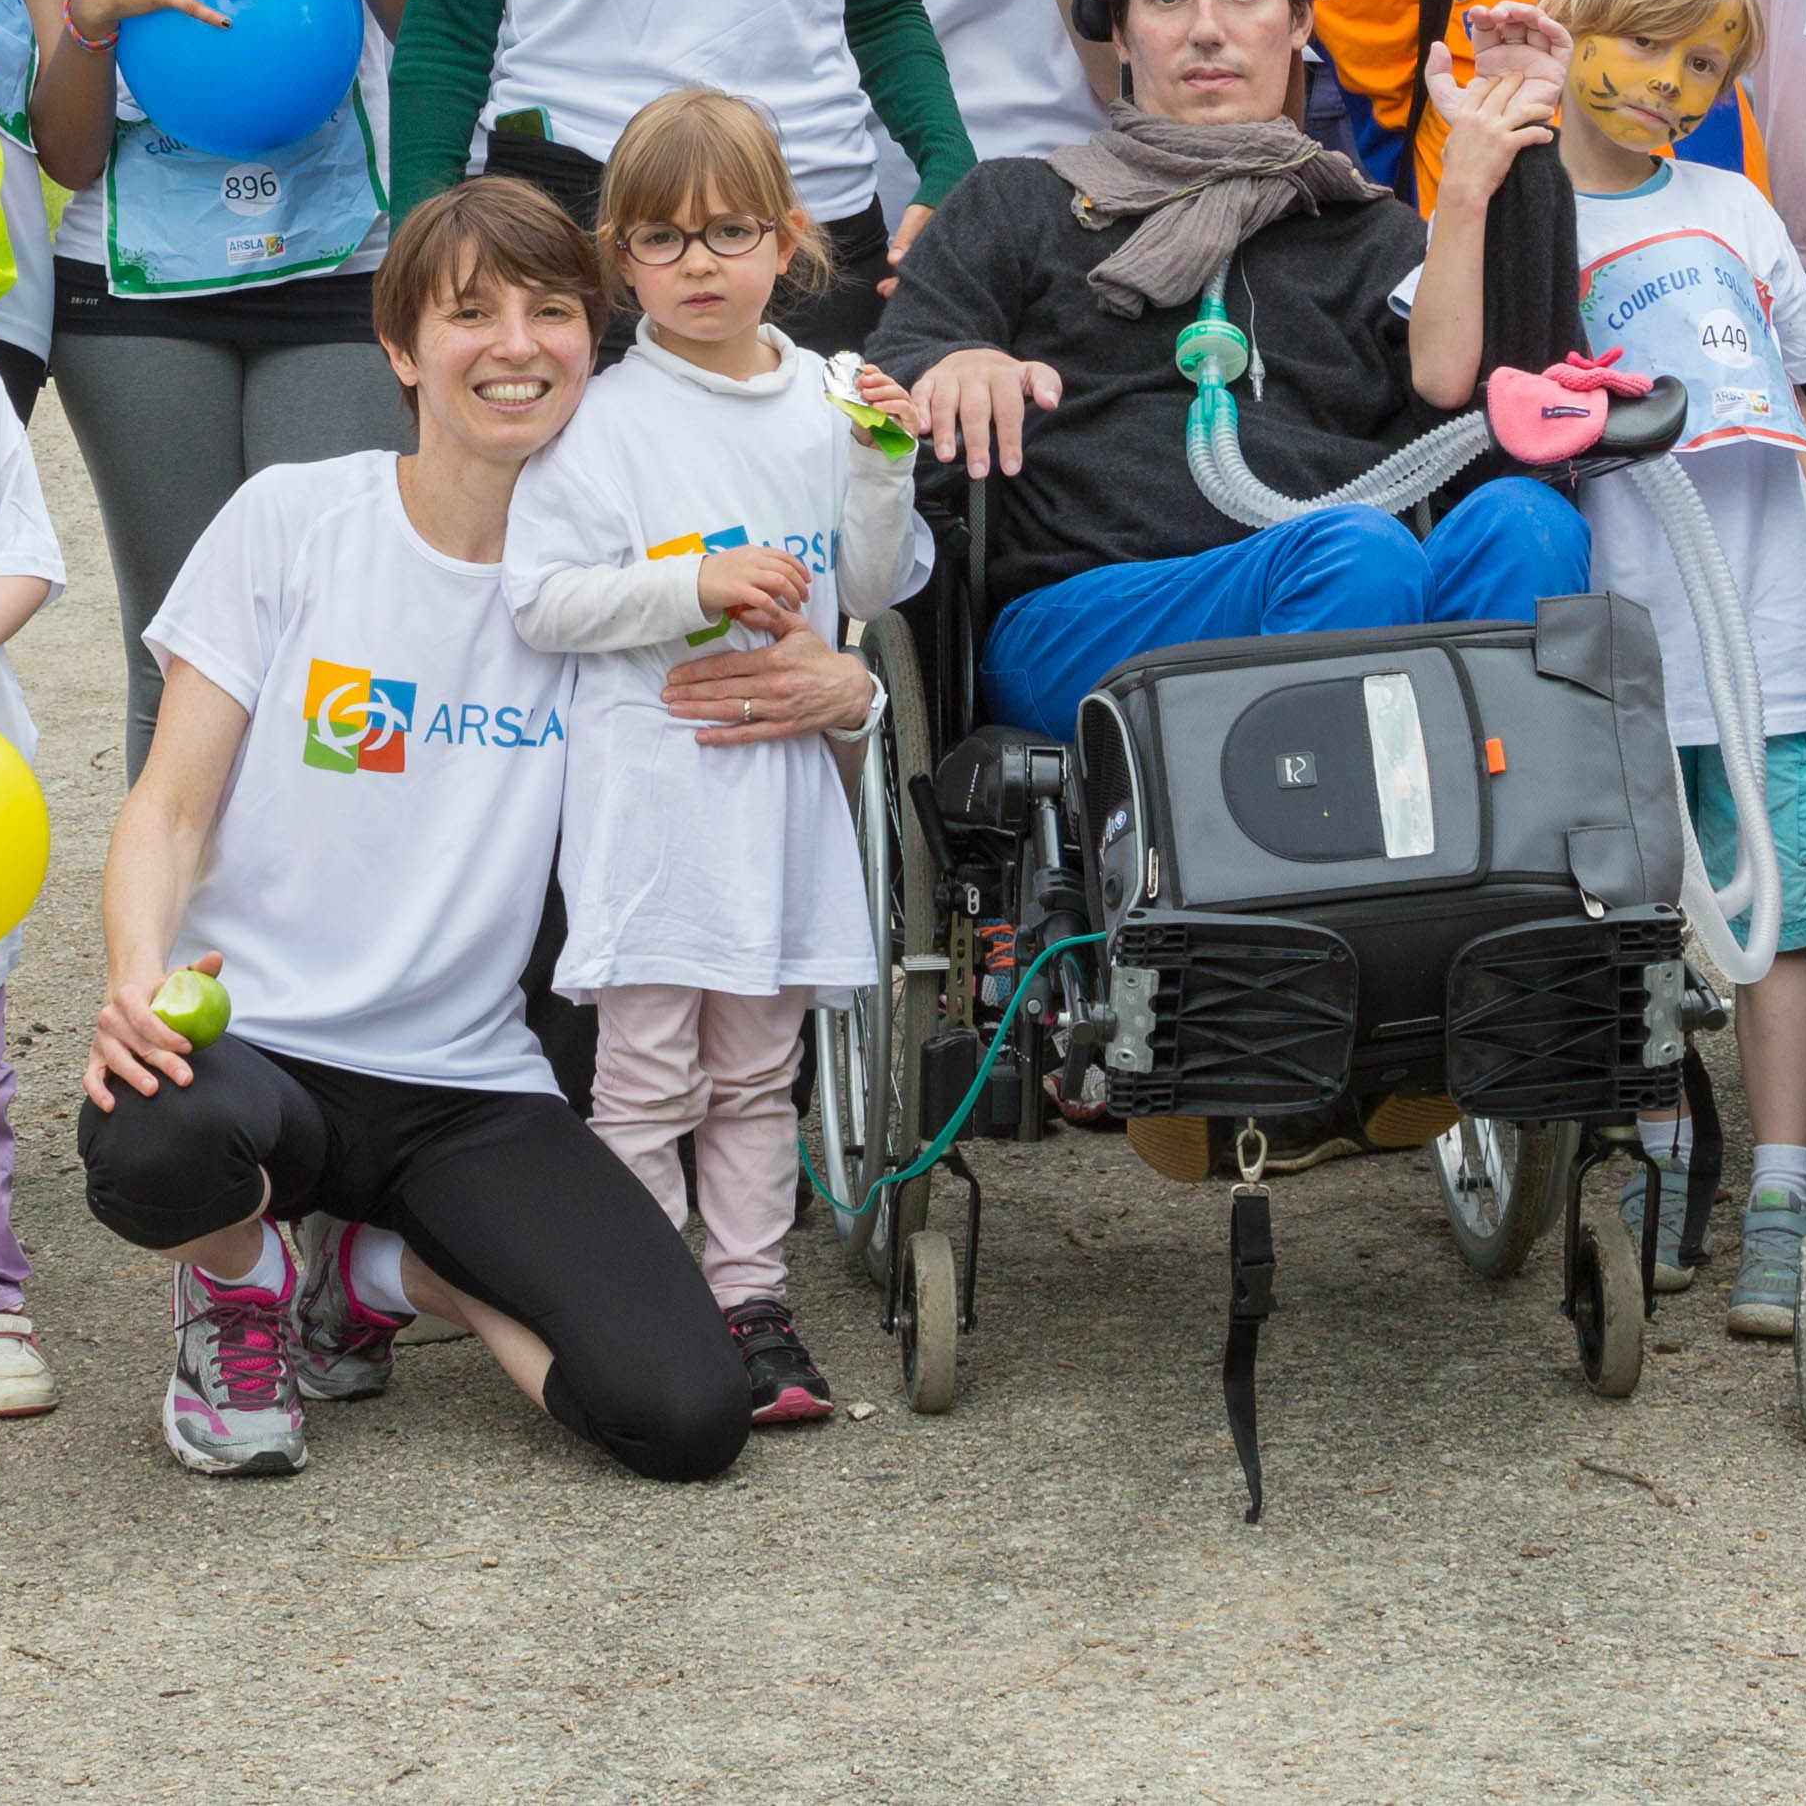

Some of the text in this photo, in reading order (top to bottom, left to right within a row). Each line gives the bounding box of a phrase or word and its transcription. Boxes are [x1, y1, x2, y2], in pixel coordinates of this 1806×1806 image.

[225, 171, 277, 200] 896
[229, 238, 264, 251] ARSLA
[1607, 266, 1702, 331] COUREUR
[1702, 325, 1747, 353] 449
